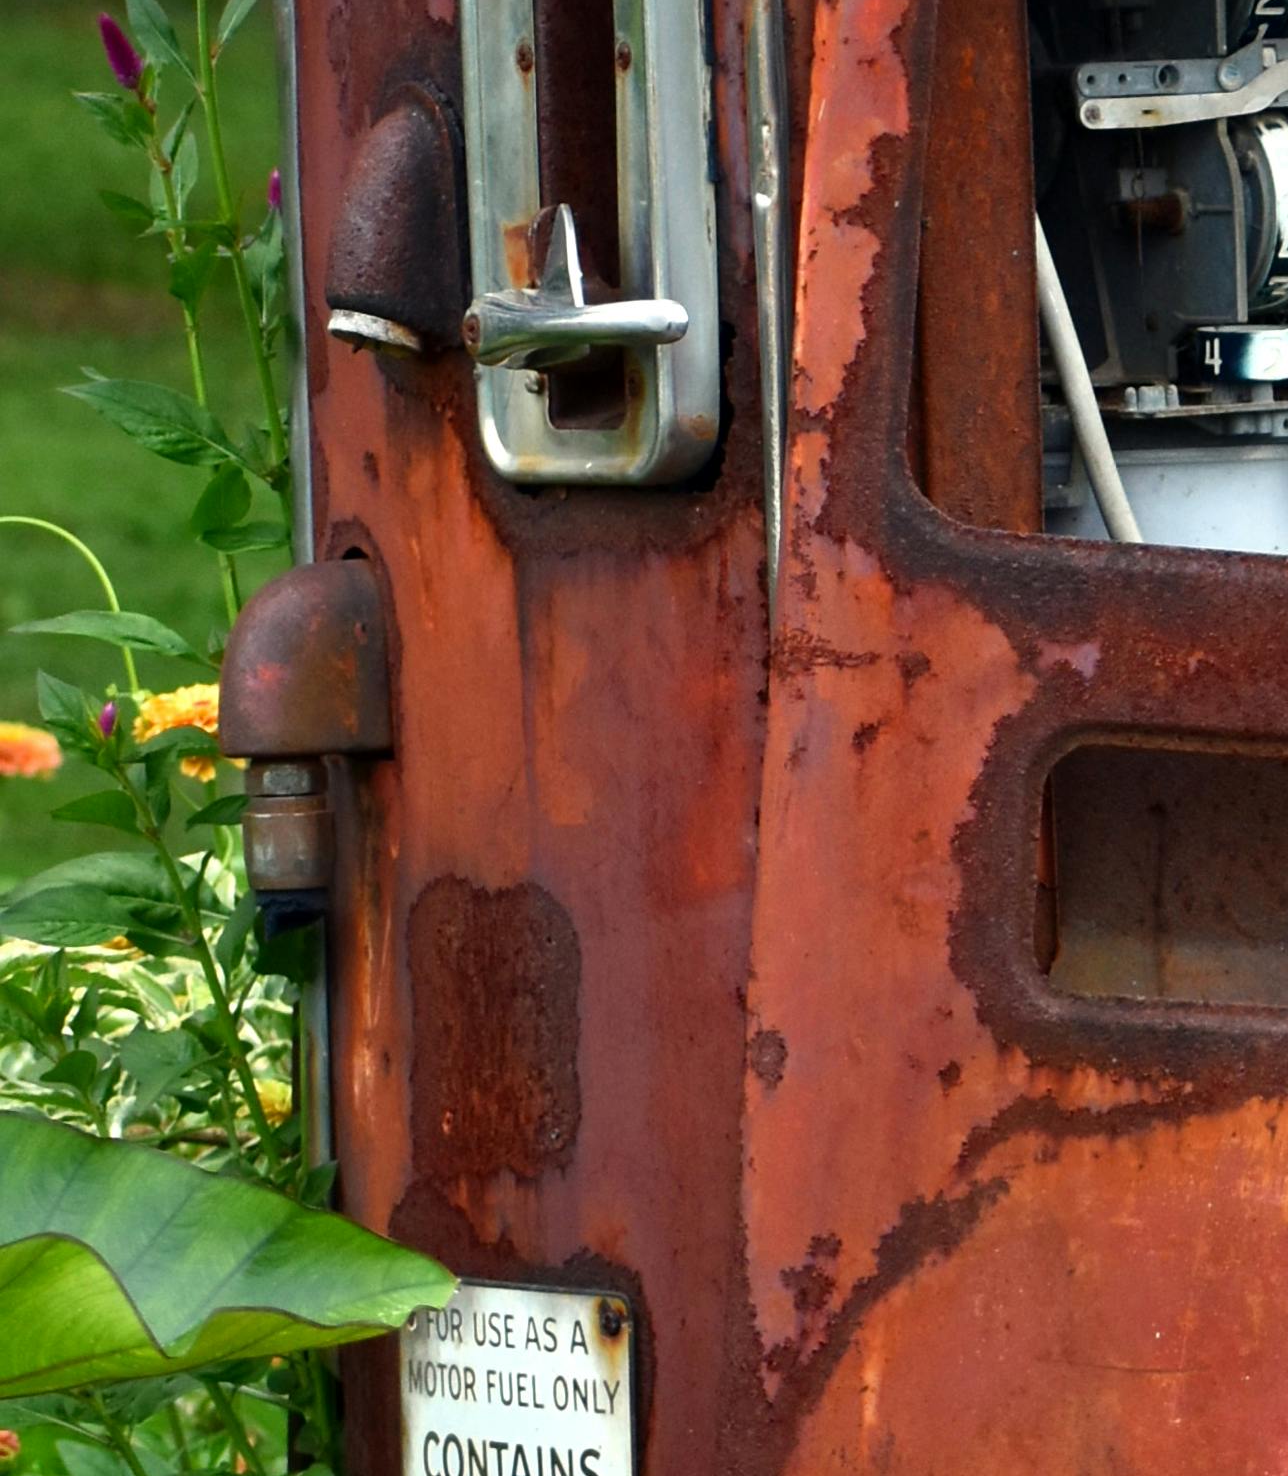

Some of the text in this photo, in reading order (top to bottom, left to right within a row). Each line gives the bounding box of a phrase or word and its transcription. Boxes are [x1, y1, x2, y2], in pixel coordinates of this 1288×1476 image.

[426, 1308, 590, 1355] FOR USE AS A
[407, 1359, 621, 1415] MOTOR FUEL ONLY
